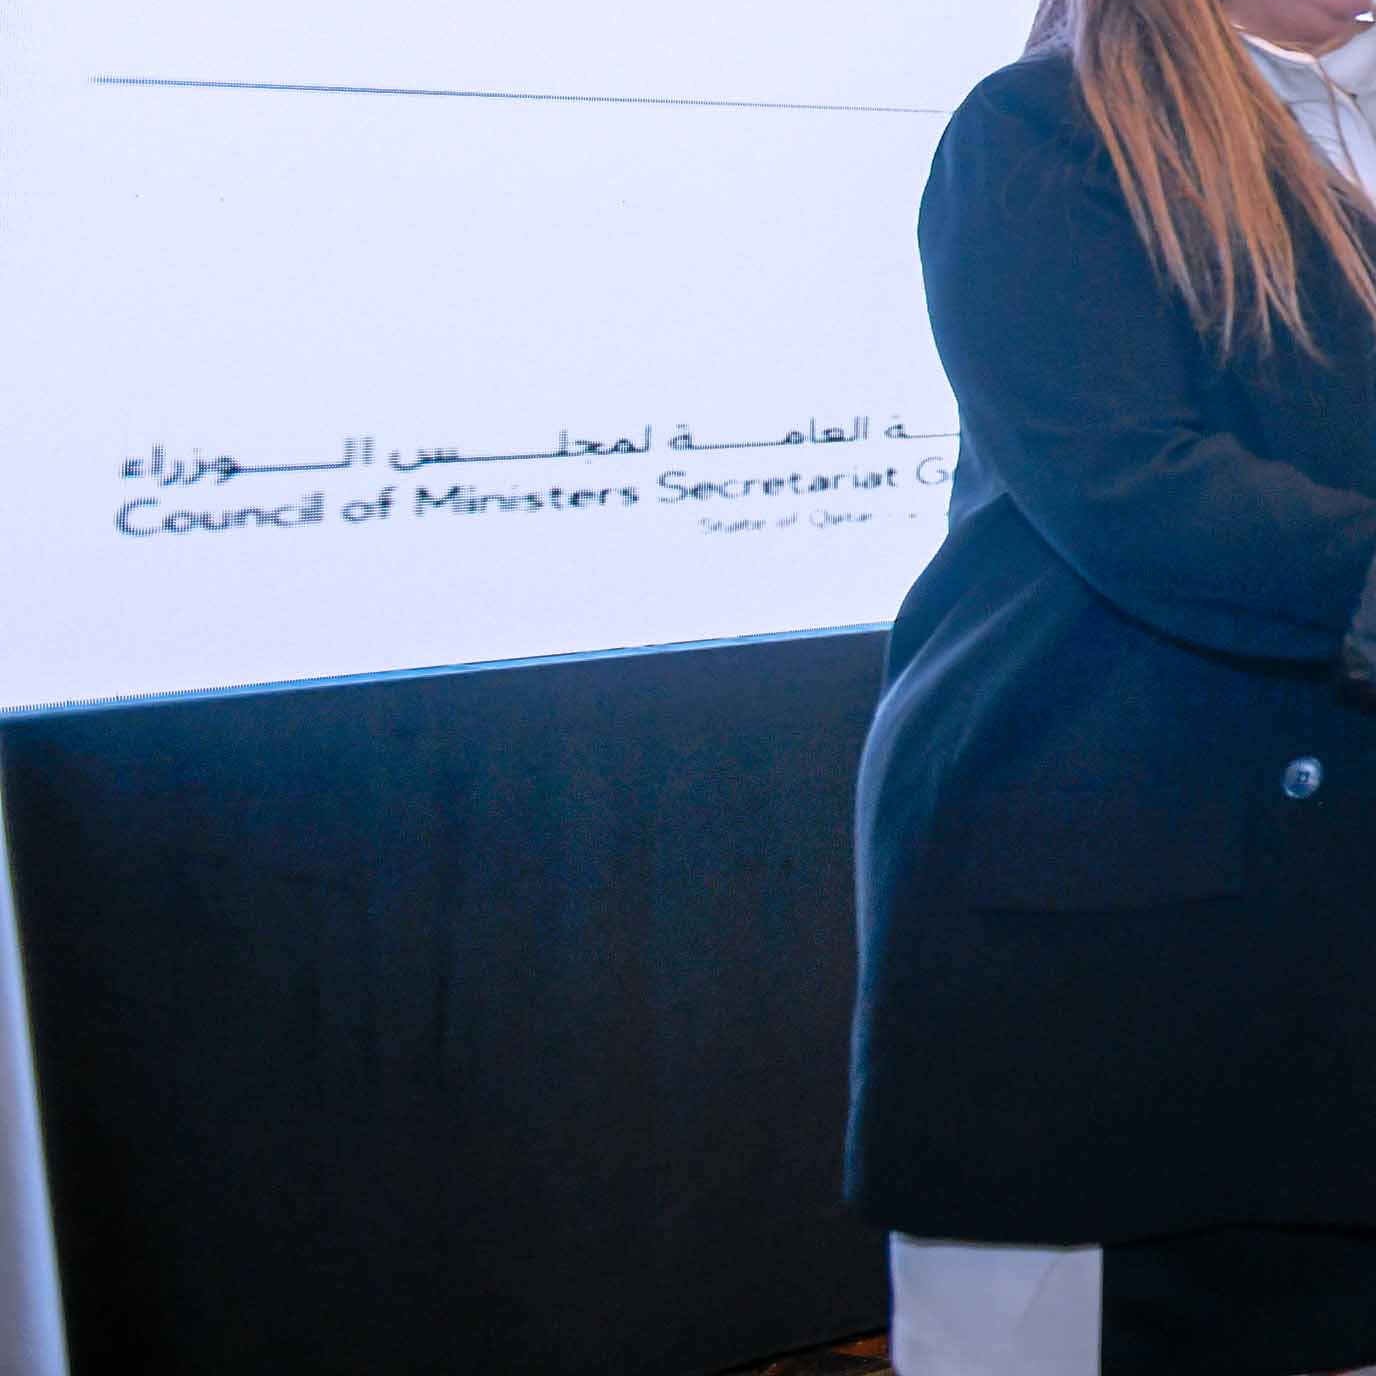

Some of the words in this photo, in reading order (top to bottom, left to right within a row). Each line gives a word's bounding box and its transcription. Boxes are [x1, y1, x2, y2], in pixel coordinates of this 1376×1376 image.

[116, 490, 326, 538] Council
[341, 485, 397, 524] of
[414, 480, 641, 518] Ministers
[657, 466, 897, 504] Secretariat
